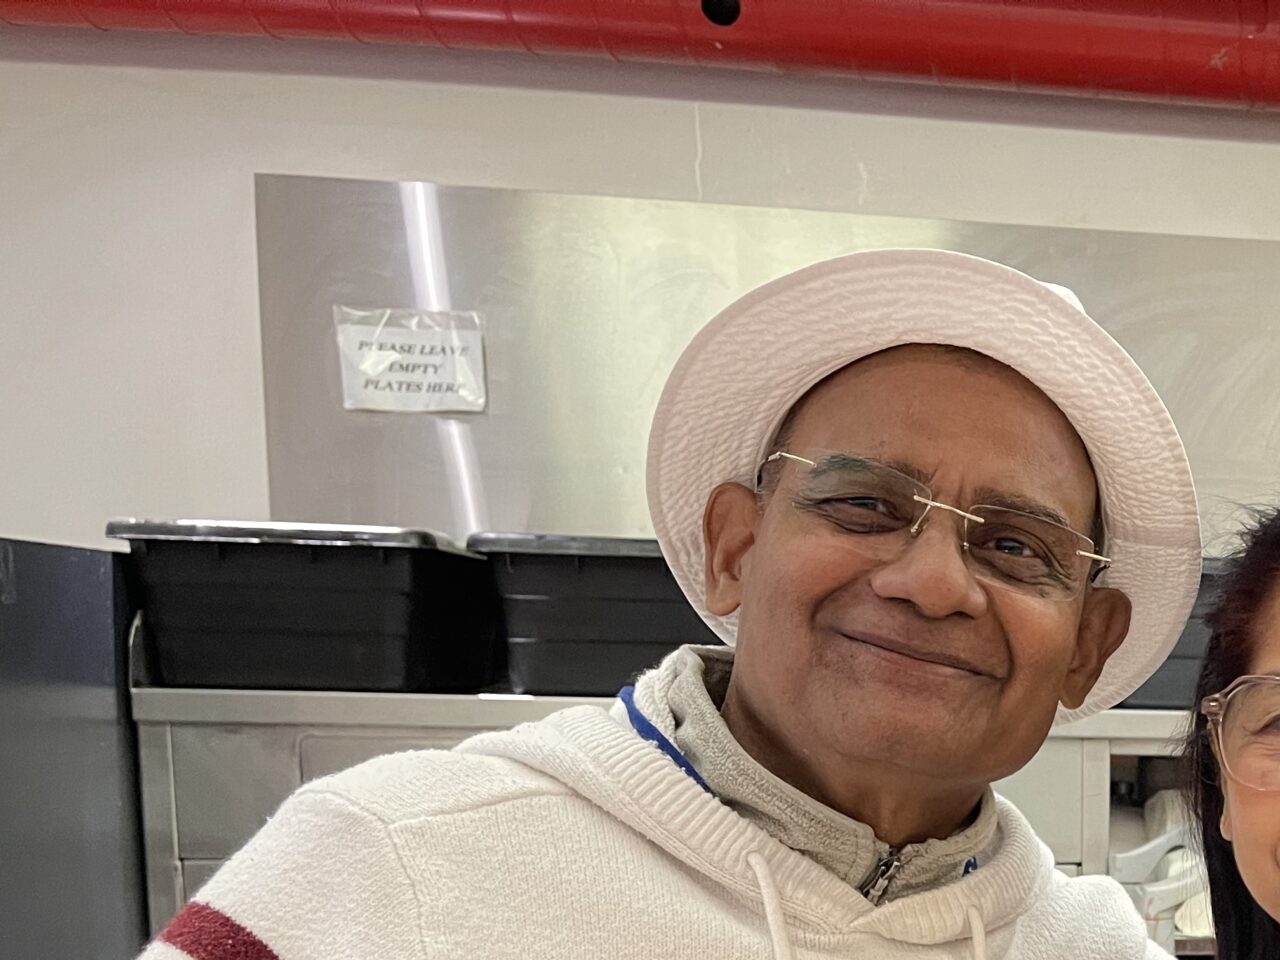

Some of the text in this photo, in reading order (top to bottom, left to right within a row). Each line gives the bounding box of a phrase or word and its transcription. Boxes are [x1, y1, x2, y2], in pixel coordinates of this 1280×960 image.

[420, 343, 468, 356] LEAVE
[388, 361, 442, 374] EMPTY
[363, 378, 460, 394] PLATES HER
